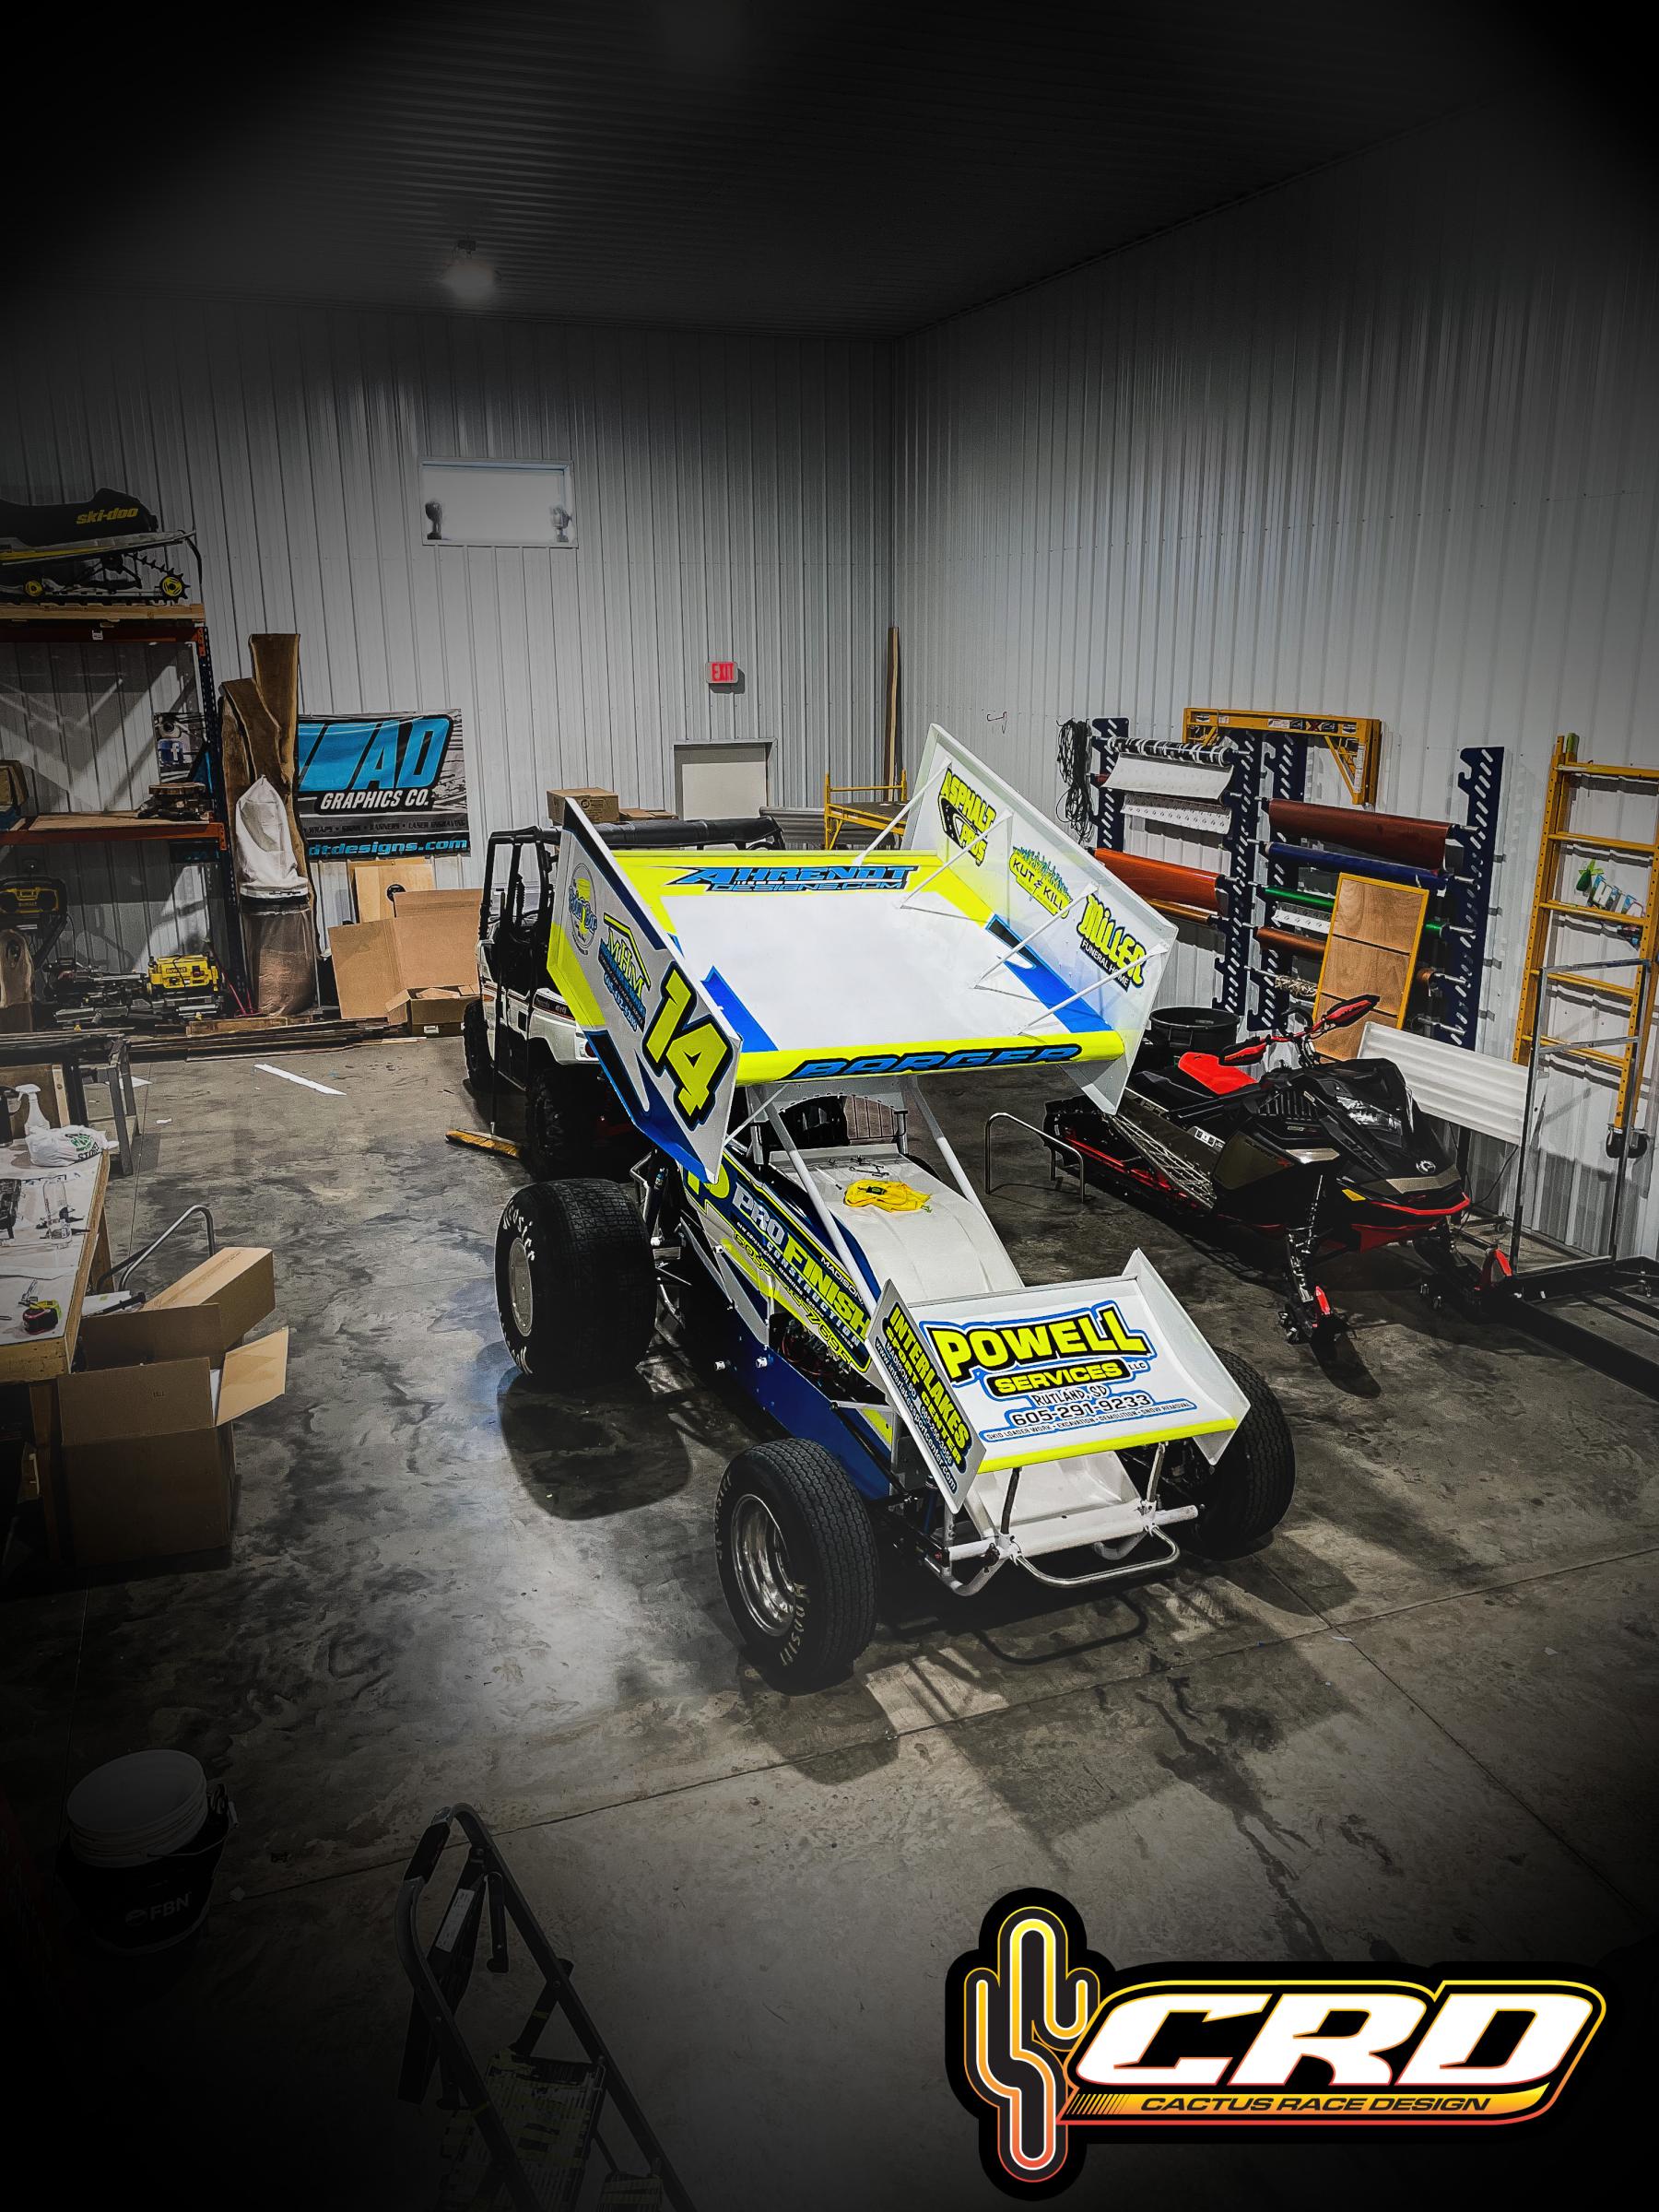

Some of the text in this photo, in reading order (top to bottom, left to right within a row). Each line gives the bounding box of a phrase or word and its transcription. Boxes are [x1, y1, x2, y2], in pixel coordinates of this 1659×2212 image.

[76, 507, 138, 524] ski-doo
[712, 663, 734, 681] EXIT
[320, 788, 429, 810] GRAPHICS CO.
[940, 771, 995, 833] ASPHALT
[676, 867, 917, 885] AHRENDT
[1013, 858, 1035, 883] KUT
[1081, 939, 1110, 970] FUNERAL
[646, 970, 727, 1116] 14
[733, 1182, 871, 1341] PRO FINISH
[766, 1241, 861, 1347] CONSTRUCTION
[931, 1309, 1148, 1381] POWELL
[889, 1307, 969, 1449] INTERLAKES
[994, 1362, 1147, 1394] SERVICES LLC
[886, 1326, 962, 1465] SPORT CENTER
[1012, 1394, 1151, 1426] 605-291-9233
[1032, 1385, 1108, 1407] RUTLAND, SD
[1031, 1425, 1052, 1433] WORK
[1057, 1418, 1095, 1430] EXCAVATION
[1099, 1410, 1138, 1421] DEMOLITION
[149, 1890, 193, 1923] FBN
